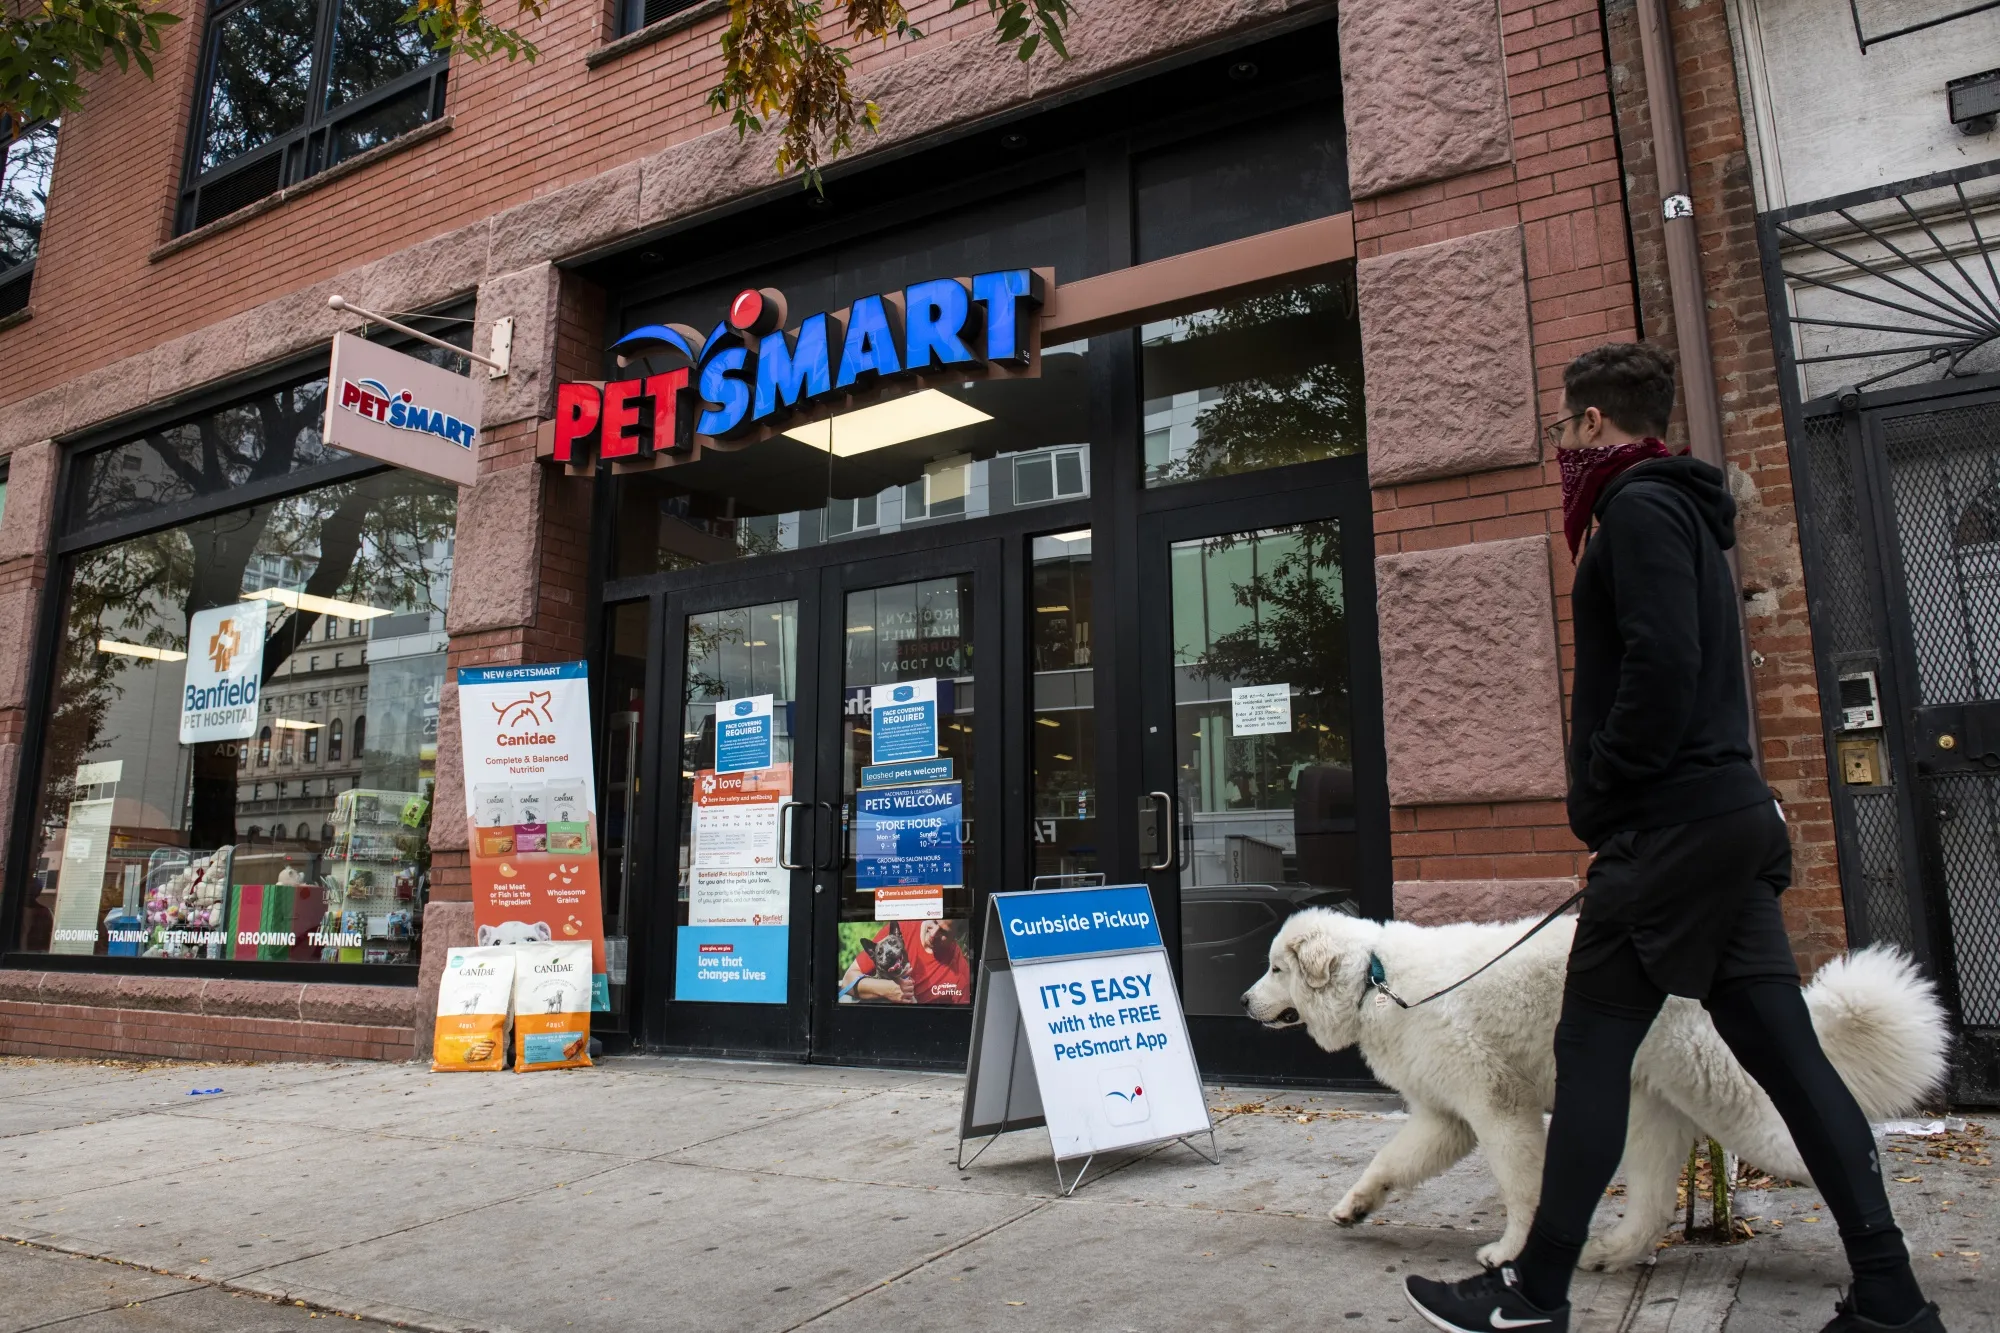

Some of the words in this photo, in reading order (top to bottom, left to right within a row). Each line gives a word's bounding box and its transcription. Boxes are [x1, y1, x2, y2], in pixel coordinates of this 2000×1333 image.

[553, 267, 1040, 464] PETSMART
[341, 380, 475, 449] PETSMART
[483, 670, 505, 680] NEW
[185, 674, 257, 712] Banfield
[897, 706, 925, 714] COVERING
[184, 713, 202, 729] PET
[204, 708, 254, 727] HOSPITAL
[883, 712, 925, 724] REQUIRED
[726, 726, 762, 737] REQUIRED
[496, 732, 556, 746] Canidae
[485, 757, 522, 766] Complete
[533, 754, 569, 763] Balanced
[509, 766, 545, 774] Nutrition
[866, 771, 894, 780] leashed
[895, 770, 912, 779] pets
[914, 766, 947, 775] welcome
[719, 778, 742, 789] love
[865, 798, 891, 811] PETS
[894, 793, 952, 808] WELCOME
[876, 820, 905, 831] STORE
[908, 818, 942, 830] HOURS
[920, 830, 938, 839] Sunday
[498, 890, 511, 898] Fish
[519, 889, 531, 897] the
[498, 899, 532, 907] Ingredient
[1009, 914, 1090, 936] Curbside
[1092, 911, 1150, 930] Pickup
[54, 929, 98, 942] GROOMING
[108, 930, 148, 943] TRAINING
[158, 931, 228, 944] VETERINARIAN
[238, 932, 296, 946] GROOMING
[307, 932, 362, 947] TRAINING
[698, 956, 719, 966] love
[721, 956, 743, 967] that
[459, 967, 496, 977] CANIDAE
[534, 964, 574, 974] CANIDAE
[698, 968, 740, 983] changes
[742, 968, 766, 980] lives
[931, 984, 962, 996] Charities
[1039, 982, 1086, 1010] IT'S
[1090, 974, 1152, 1003] EASY
[1048, 1013, 1085, 1035] with
[1088, 1010, 1115, 1030] the
[1118, 1004, 1162, 1024] FREE
[1053, 1036, 1131, 1061] PetSmart
[1135, 1031, 1168, 1050] App
